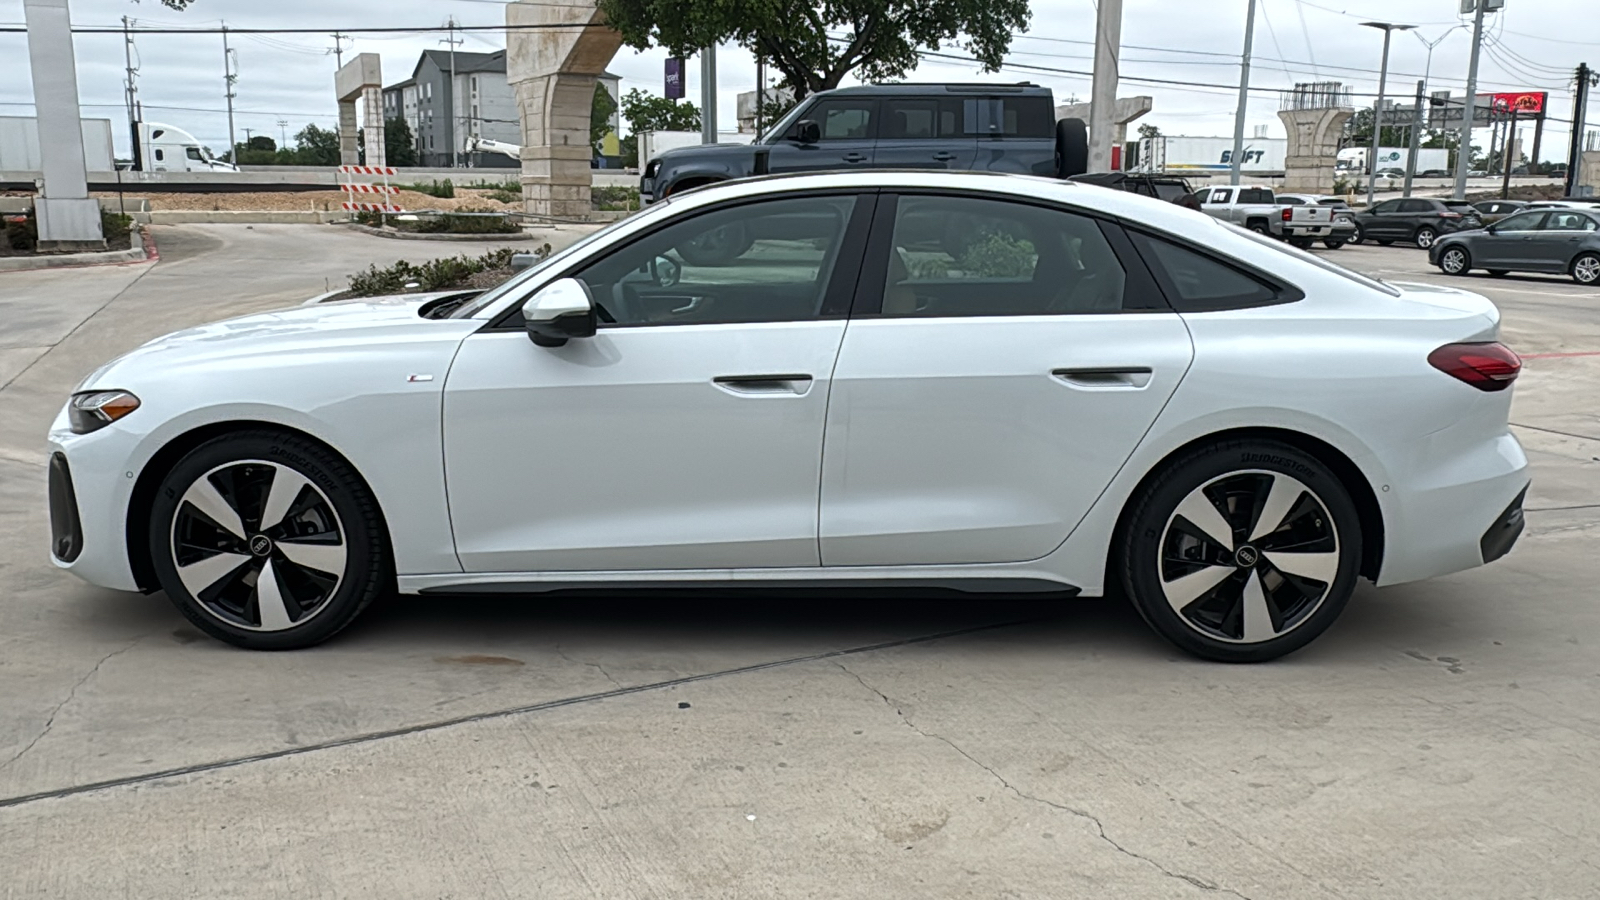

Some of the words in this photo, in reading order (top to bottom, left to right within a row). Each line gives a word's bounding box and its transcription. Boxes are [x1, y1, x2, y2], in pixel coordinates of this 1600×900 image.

[1220, 149, 1265, 164] SIFT
[270, 446, 338, 490] BRIDGESTONE
[1241, 452, 1316, 478] BRIDGESTONE
